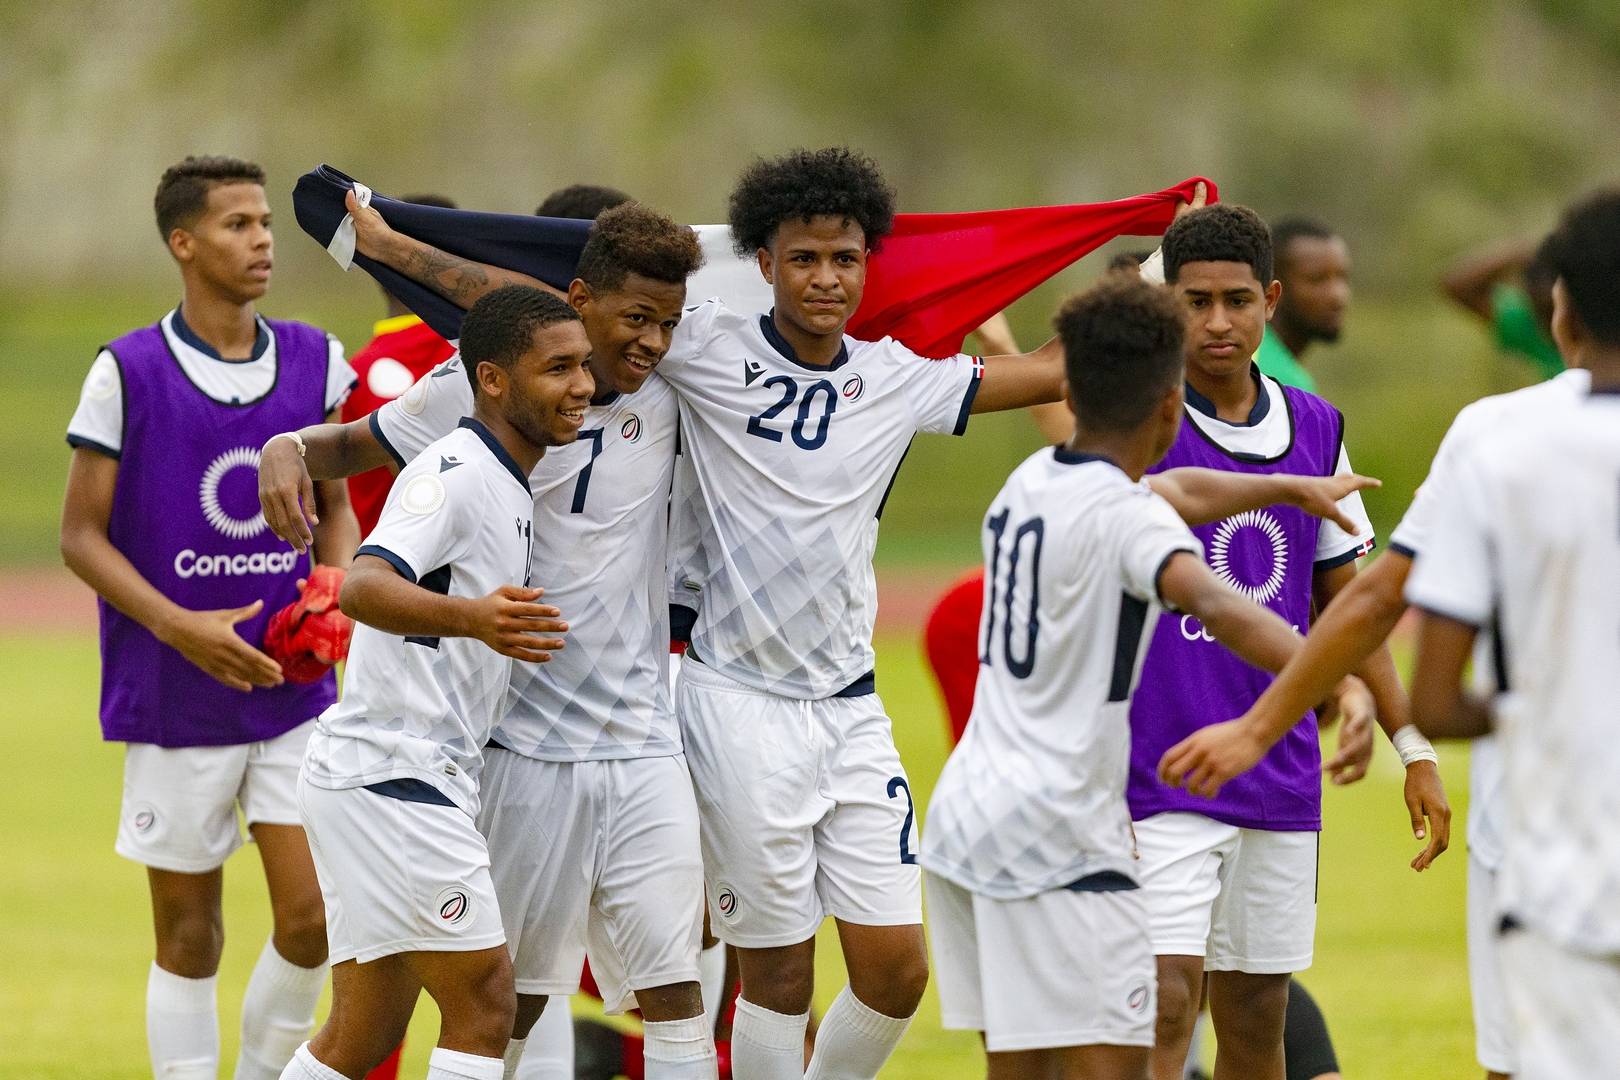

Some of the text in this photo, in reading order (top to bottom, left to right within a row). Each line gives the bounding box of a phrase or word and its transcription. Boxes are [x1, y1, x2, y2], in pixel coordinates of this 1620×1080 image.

[746, 375, 838, 451] 20
[570, 426, 605, 514] 7
[979, 506, 1044, 679] 10
